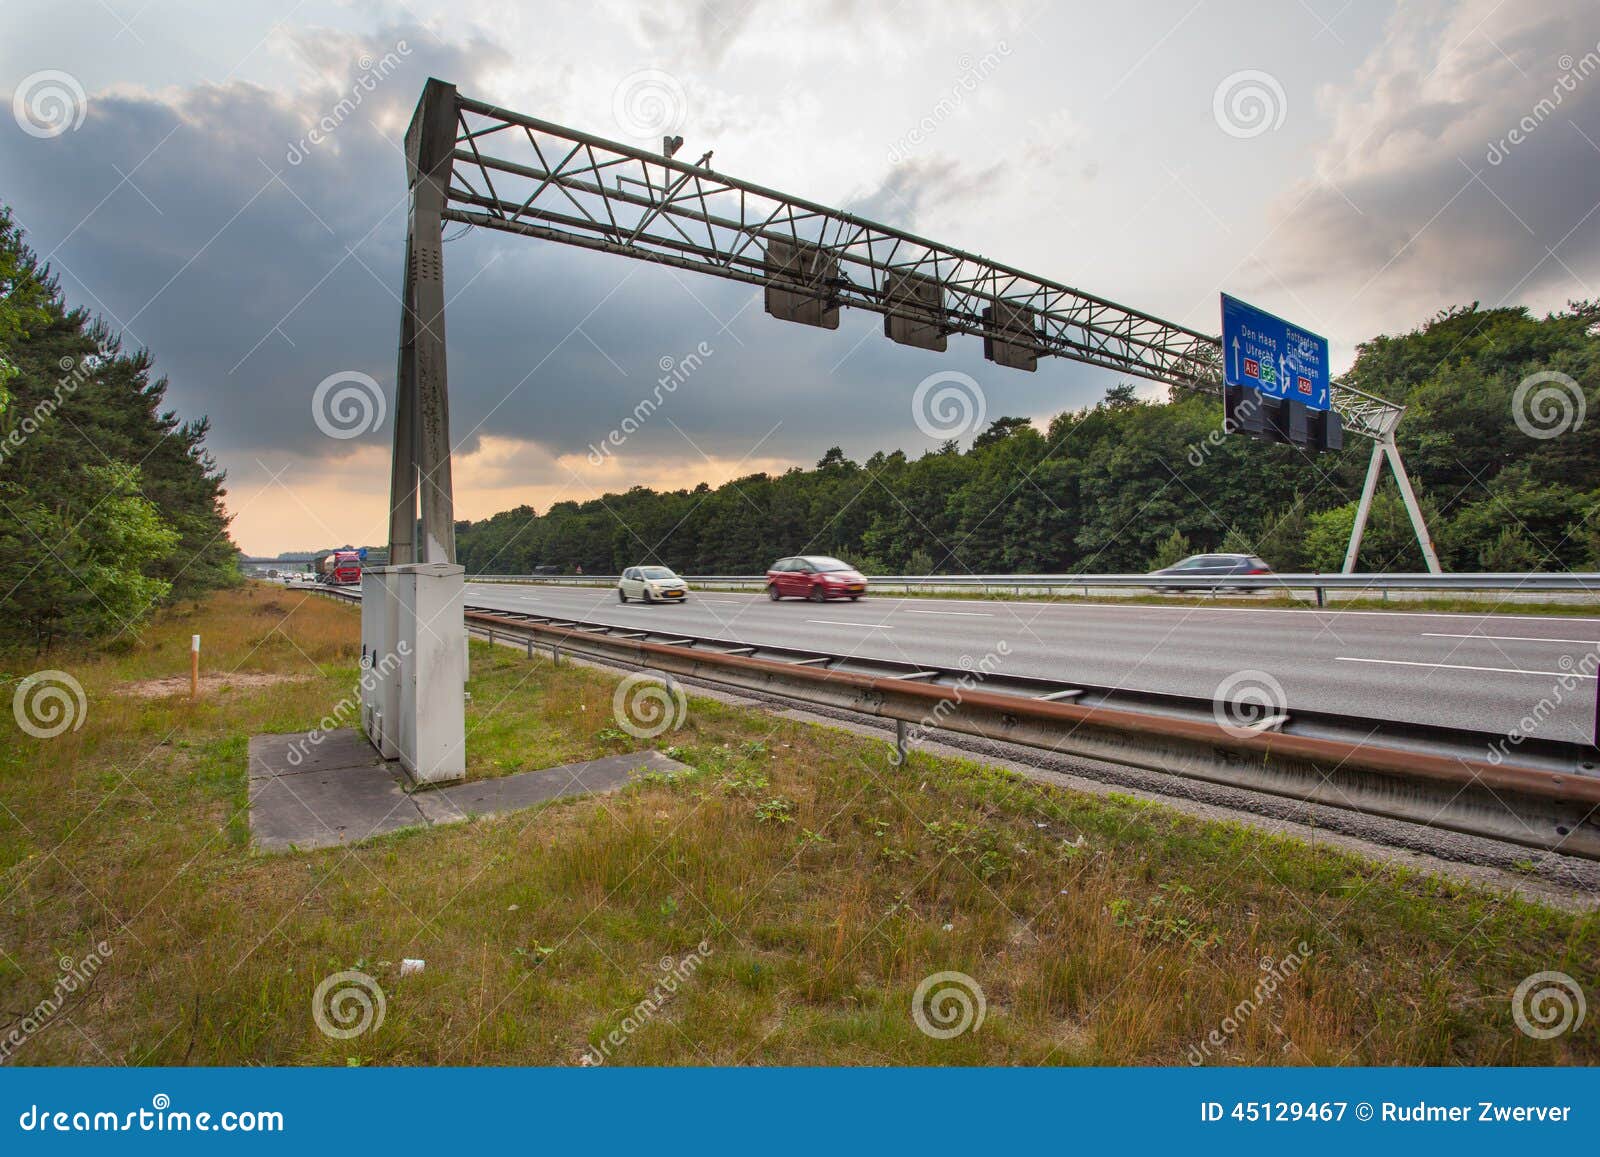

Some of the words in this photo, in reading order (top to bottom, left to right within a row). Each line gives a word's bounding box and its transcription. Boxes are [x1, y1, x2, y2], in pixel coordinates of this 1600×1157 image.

[1241, 324, 1256, 340] Den
[1258, 330, 1277, 351] Haag
[1245, 341, 1275, 360] Utrecht
[1245, 361, 1258, 376] A12
[1299, 379, 1311, 394] A50
